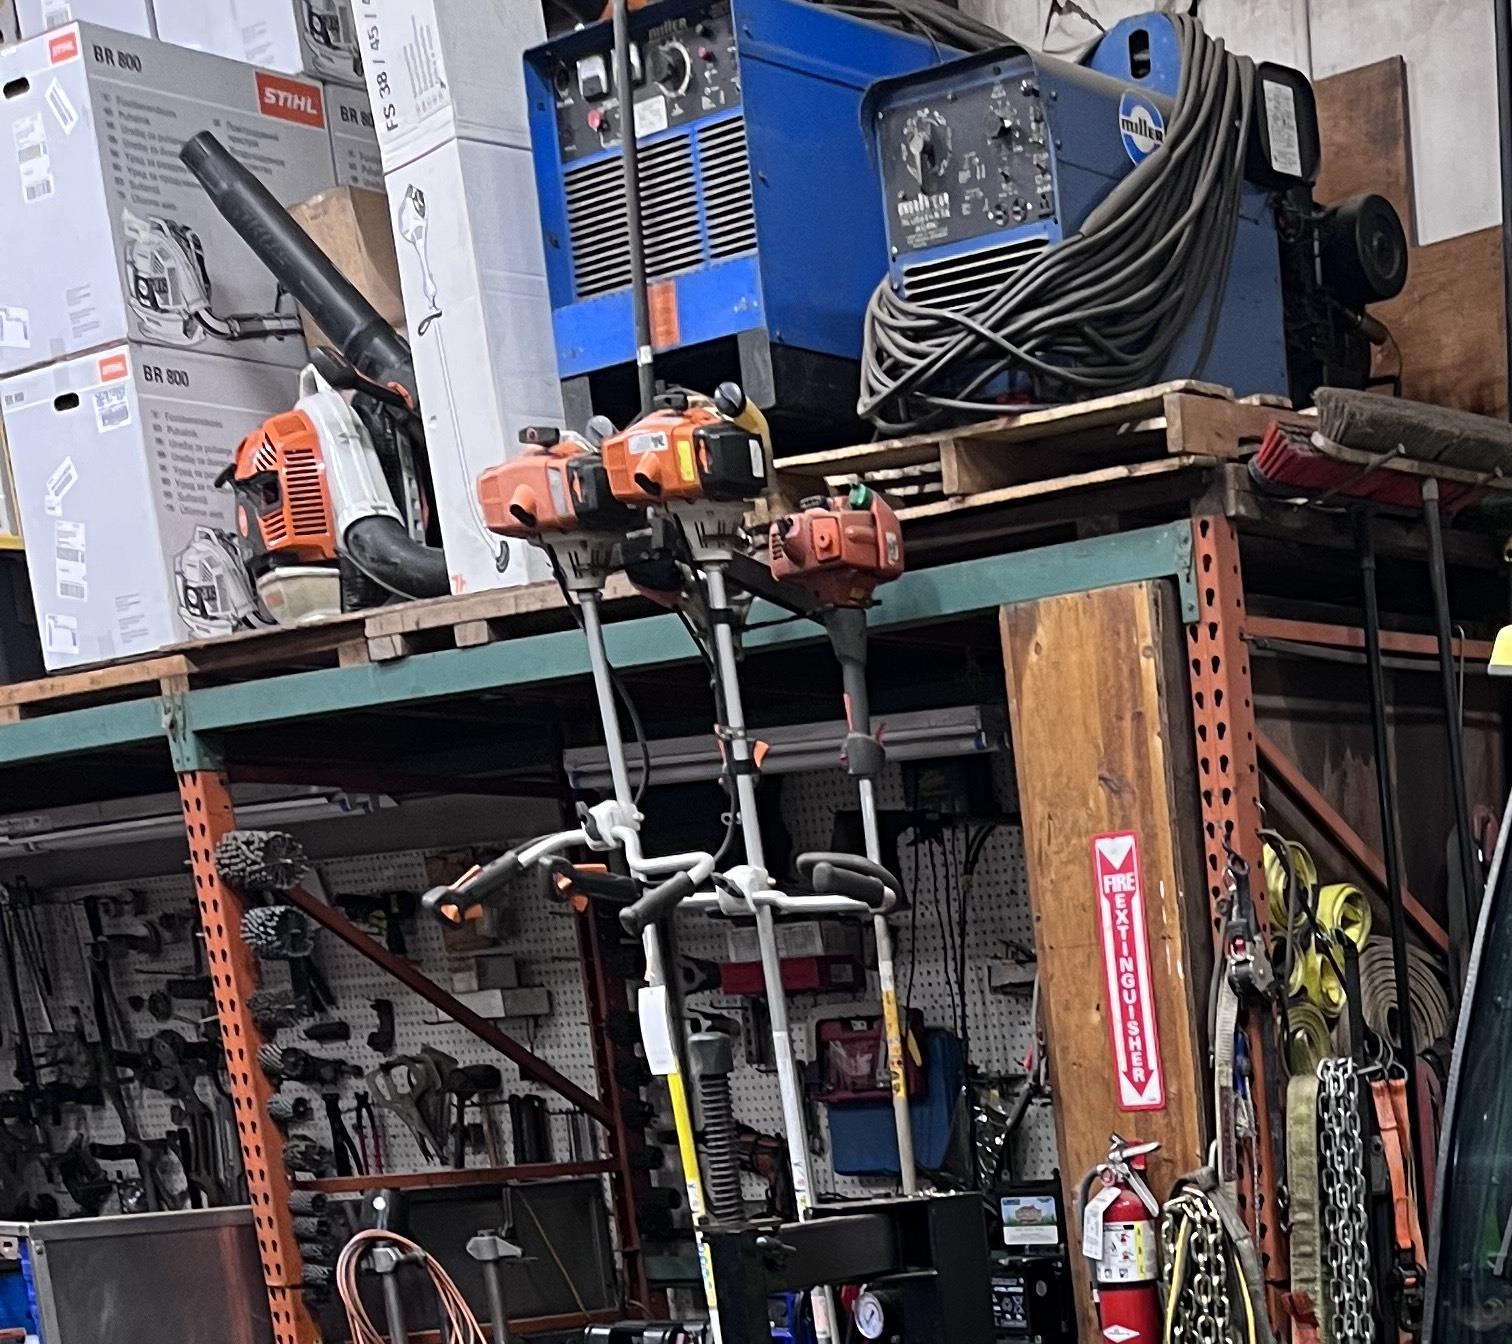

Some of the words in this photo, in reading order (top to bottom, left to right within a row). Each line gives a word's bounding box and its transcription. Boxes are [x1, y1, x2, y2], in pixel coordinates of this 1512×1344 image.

[367, 25, 380, 51] 45
[93, 44, 116, 66] BR
[116, 50, 143, 73] 800
[376, 71, 391, 99] 38
[264, 87, 318, 115] STIHL
[384, 103, 399, 133] FS
[142, 364, 164, 384] BR
[166, 369, 190, 388] 800
[1103, 871, 1137, 894] FIRE
[1114, 892, 1147, 1083] EXTINGUISHER
